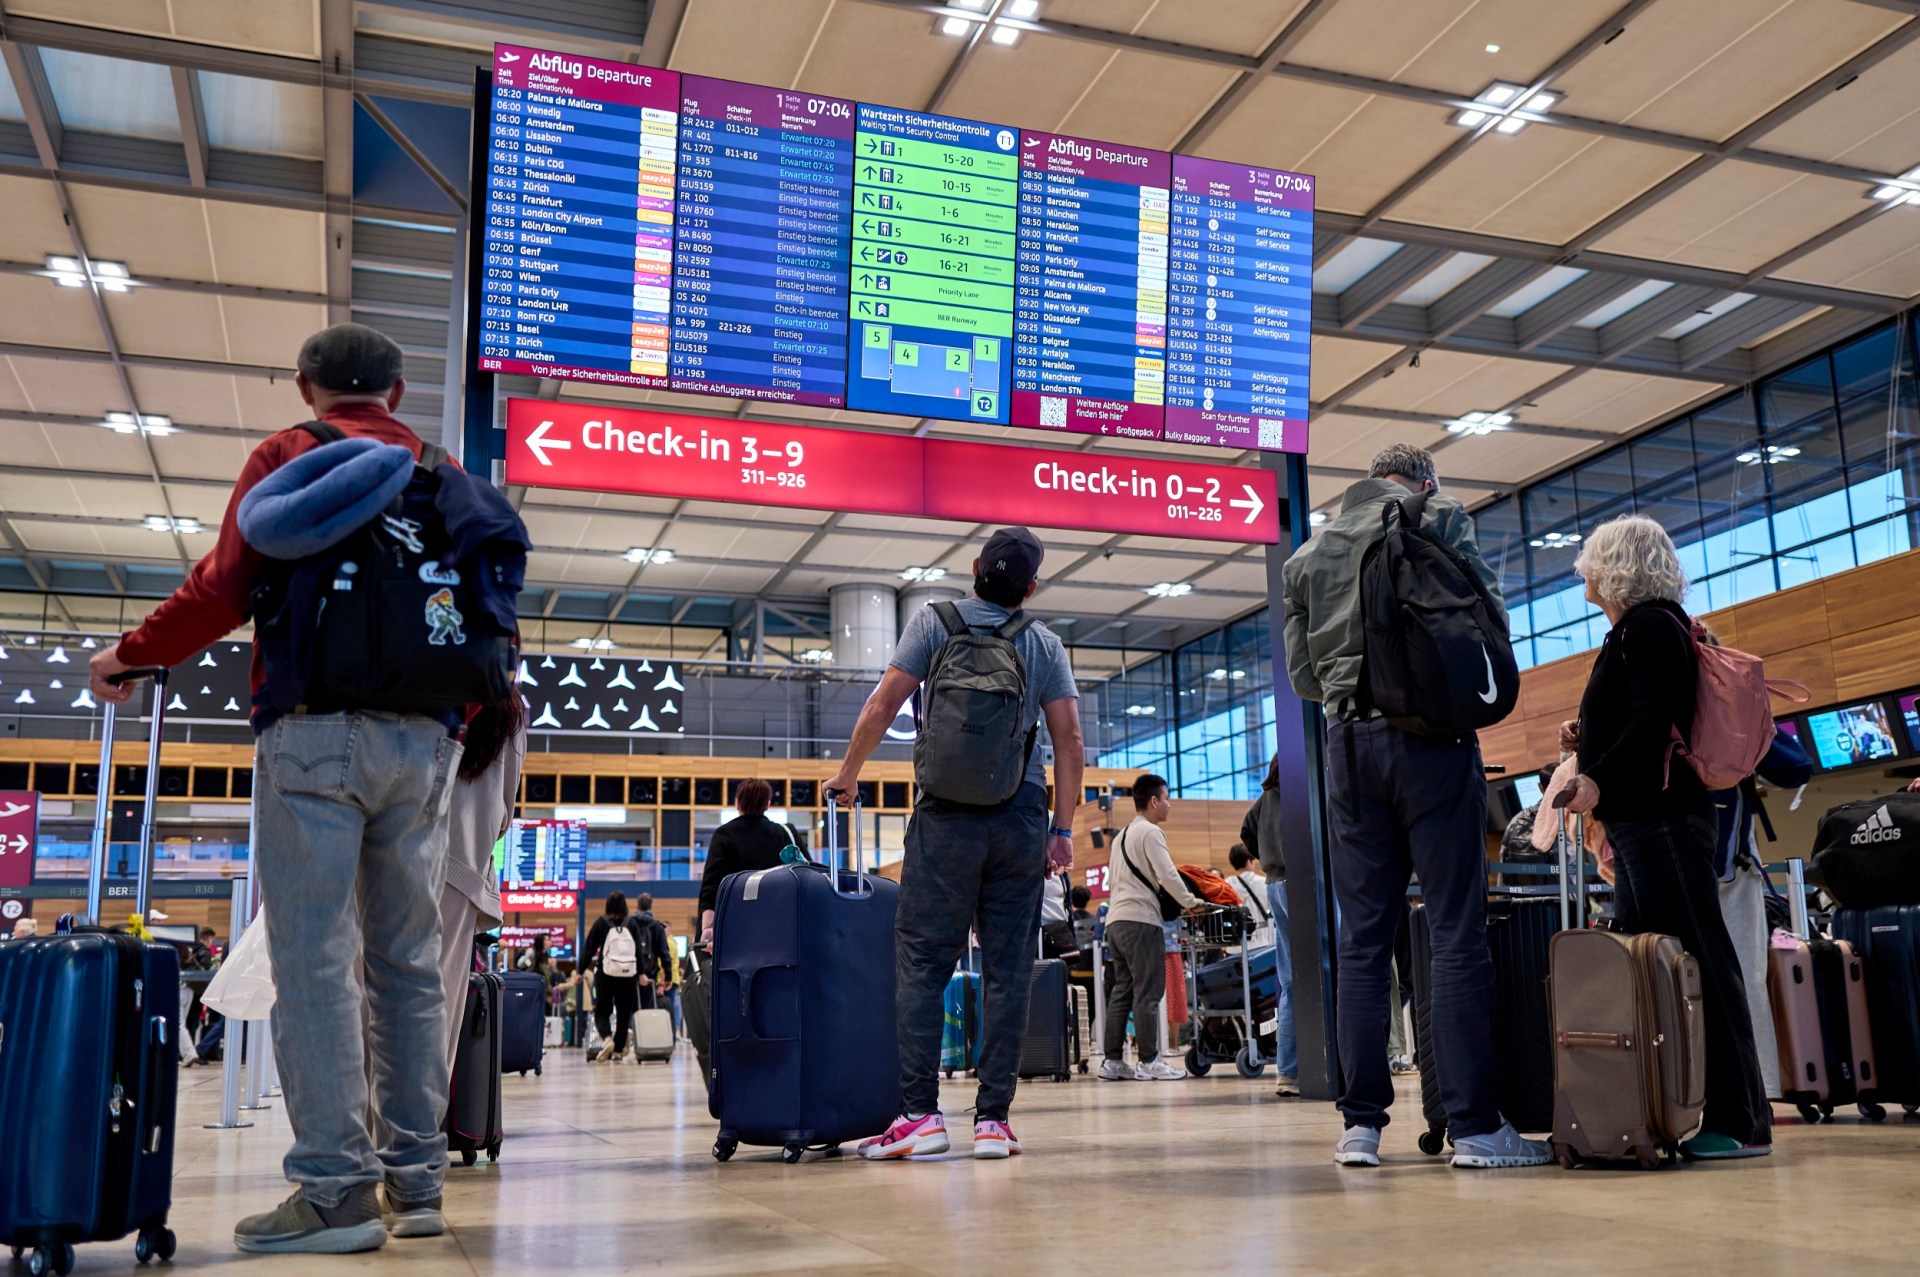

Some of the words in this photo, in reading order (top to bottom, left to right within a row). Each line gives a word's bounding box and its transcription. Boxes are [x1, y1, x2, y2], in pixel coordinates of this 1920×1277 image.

[498, 68, 512, 76] Zeit
[528, 53, 582, 79] Abflug
[587, 65, 652, 87] Departure
[498, 76, 513, 85] Time
[528, 81, 573, 94] Destination/via
[497, 87, 521, 99] 05:20
[527, 92, 554, 104] Palma
[555, 96, 566, 105] de
[567, 98, 603, 111] Mallorca
[684, 98, 698, 108] Flug
[776, 94, 782, 108] 1
[785, 95, 800, 103] Seite
[683, 106, 700, 115] Flight
[727, 105, 752, 114] Schalter
[785, 103, 799, 111] Page
[807, 98, 850, 119] 07:04
[496, 113, 520, 124] 06:00
[525, 117, 574, 132] Amsterdam
[726, 113, 751, 122] Check-in
[782, 114, 816, 126] Bemerkung
[861, 108, 903, 123] Wartezeit
[905, 115, 990, 136] Sicherheitskontrolle
[683, 116, 693, 125] SR
[695, 118, 714, 129] 2412
[726, 123, 758, 136] 011-012
[781, 132, 812, 144] Erwartet
[813, 137, 835, 148] 07:20
[781, 121, 802, 131] Remark
[860, 119, 886, 132] Waiting
[888, 123, 905, 133] Time
[906, 126, 933, 139] Security
[934, 131, 959, 141] Control
[494, 139, 519, 150] 06:10
[525, 143, 553, 155] Dublin
[1001, 135, 1011, 146] T1
[682, 142, 692, 151] KL
[694, 143, 714, 154] 1770
[725, 148, 758, 160] 811-816
[780, 156, 811, 168] Erwartet
[812, 161, 834, 172] 07:45
[898, 147, 902, 157] 1
[1048, 138, 1092, 161] Abflug
[1095, 148, 1148, 167] Departure
[943, 153, 974, 167] 15-20
[681, 166, 691, 175] FR
[692, 168, 712, 178] 3670
[779, 181, 808, 194] Einstieg
[809, 185, 839, 197] beendet
[896, 173, 903, 184] 2
[1023, 170, 1042, 180] 08:50
[1047, 173, 1075, 185] Helsinki
[1248, 170, 1256, 183] 3
[1275, 174, 1310, 192] 07:04
[942, 180, 971, 193] 10-15
[895, 201, 902, 211] 4
[941, 206, 959, 218] 1-6
[1173, 193, 1183, 201] AY
[1184, 194, 1200, 204] 1432
[1209, 198, 1236, 209] 511-516
[1256, 205, 1269, 214] Self
[1269, 207, 1291, 218] Service
[491, 203, 515, 214] 06:55
[522, 207, 554, 219] London
[555, 211, 572, 223] City
[573, 214, 602, 226] Airport
[895, 227, 901, 238] 5
[679, 229, 690, 238] BA
[691, 230, 712, 241] 8490
[777, 242, 806, 255] Einstieg
[807, 246, 837, 258] beendet
[940, 233, 969, 246] 16-21
[896, 254, 907, 263] T2
[939, 259, 968, 272] 16-21
[938, 287, 963, 297] Priority
[487, 294, 511, 305] 07:05
[518, 297, 550, 309] London
[551, 301, 568, 312] LHR
[1019, 298, 1039, 308] 09:20
[1044, 301, 1060, 310] New
[1060, 303, 1076, 313] York
[1077, 306, 1089, 314] JFK
[951, 316, 978, 326] Runway
[675, 317, 687, 326] BA
[690, 318, 705, 328] 999
[718, 322, 752, 333] 221-226
[774, 328, 803, 341] Einstieg
[1170, 317, 1179, 326] DL
[1182, 318, 1194, 327] 093
[1205, 322, 1233, 332] 011-016
[1253, 328, 1290, 340] Abfertigung
[874, 331, 880, 342] 5
[484, 346, 509, 357] 07:20
[515, 349, 555, 362] München
[902, 348, 910, 359] 4
[984, 344, 989, 355] 1
[484, 359, 502, 369] BER
[954, 354, 960, 365] 2
[531, 365, 548, 374] Von
[548, 366, 570, 376] jeder
[572, 369, 650, 385] Sicherheitskontrolle
[652, 378, 668, 387] sind
[672, 380, 708, 391] sämtliche
[709, 384, 755, 396] Abfluggates
[673, 367, 684, 376] LH
[686, 369, 705, 378] 1963
[772, 378, 801, 390] Einstieg
[1016, 381, 1036, 390] 09:30
[1041, 383, 1067, 393] London
[1068, 386, 1082, 395] STN
[979, 399, 990, 409] T2
[1076, 399, 1102, 408] Weitere
[1102, 402, 1128, 412] Abflüge
[1177, 398, 1194, 407] 2789
[1251, 405, 1263, 414] Self
[1264, 407, 1285, 416] Service
[1076, 408, 1097, 418] finden
[1098, 411, 1108, 419] Sie
[1109, 412, 1122, 420] hier
[1201, 412, 1216, 420] Scan
[1217, 413, 1227, 421] for
[1228, 414, 1250, 423] further
[1216, 423, 1250, 433] Departures
[582, 420, 730, 461] Check-in
[1165, 431, 1182, 441] Bulky
[1184, 432, 1210, 443] Baggage
[1034, 462, 1156, 498] Check-in
[1850, 827, 1901, 844] adidas
[108, 886, 128, 896] BER
[1589, 884, 1602, 892] BER
[6, 904, 20, 914] T2
